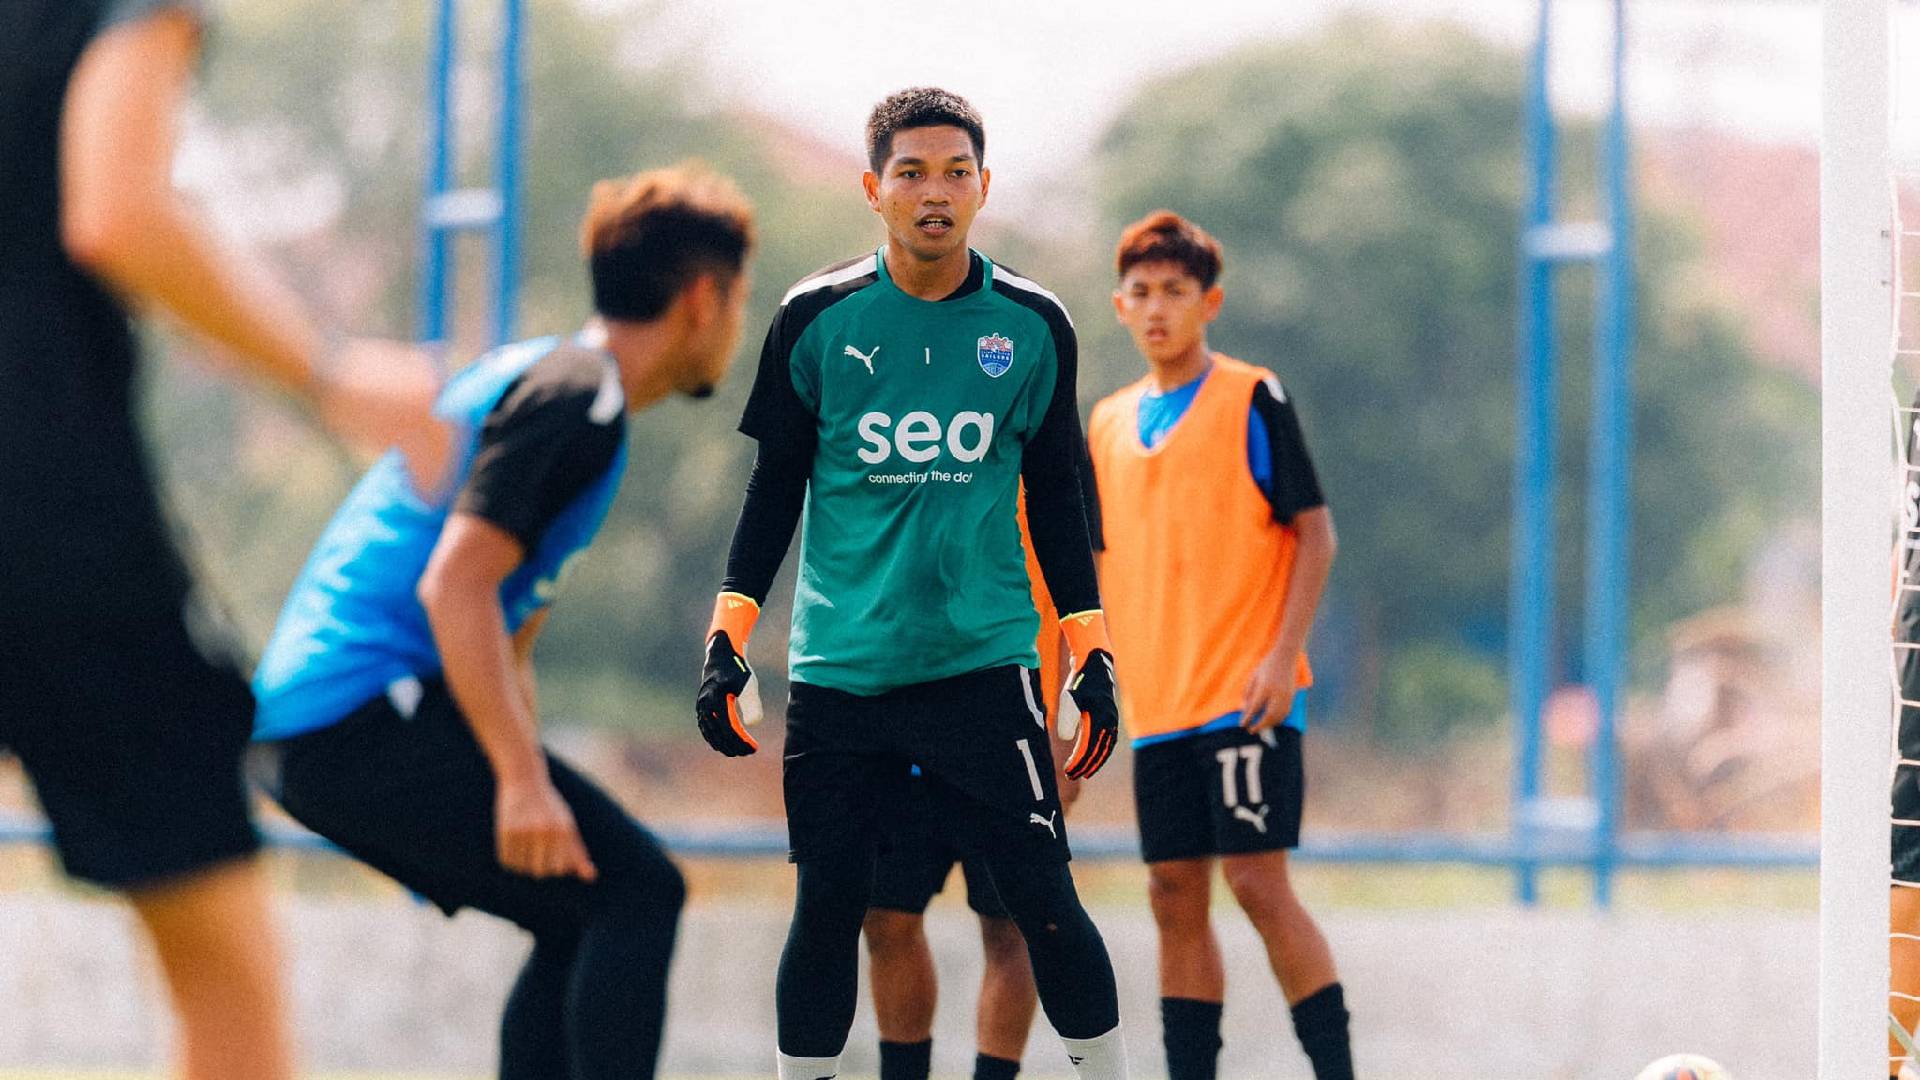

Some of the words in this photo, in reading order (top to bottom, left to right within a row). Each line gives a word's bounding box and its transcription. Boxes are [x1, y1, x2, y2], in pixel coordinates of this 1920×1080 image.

[925, 347, 930, 365] 1
[857, 410, 995, 465] sea
[931, 469, 952, 482] the
[953, 471, 973, 484] do
[1016, 738, 1044, 801] 1
[1215, 744, 1264, 808] 11
